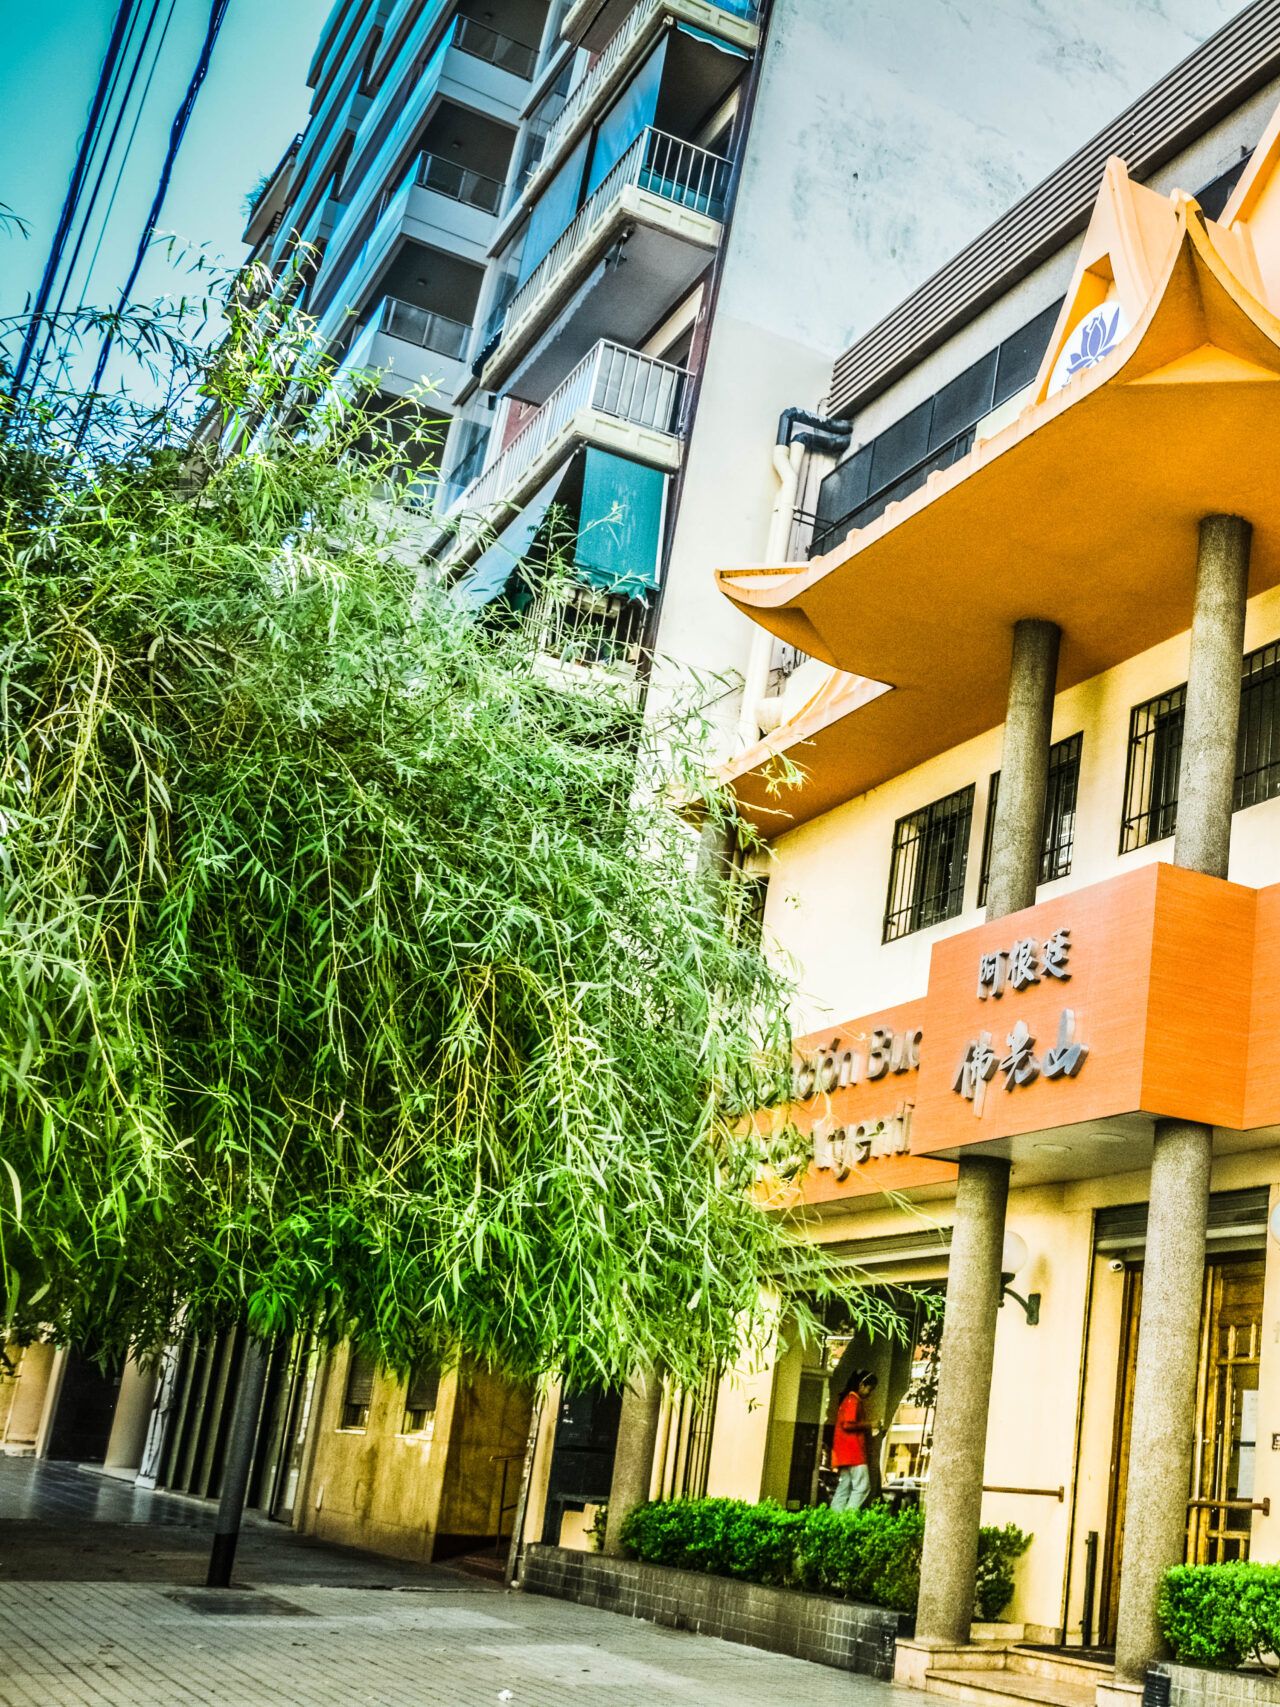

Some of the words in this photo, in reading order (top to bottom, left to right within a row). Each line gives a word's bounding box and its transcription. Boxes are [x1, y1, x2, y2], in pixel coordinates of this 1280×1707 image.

[977, 927, 1072, 1001] 阿根廷
[953, 1008, 1089, 1119] 佛光山
